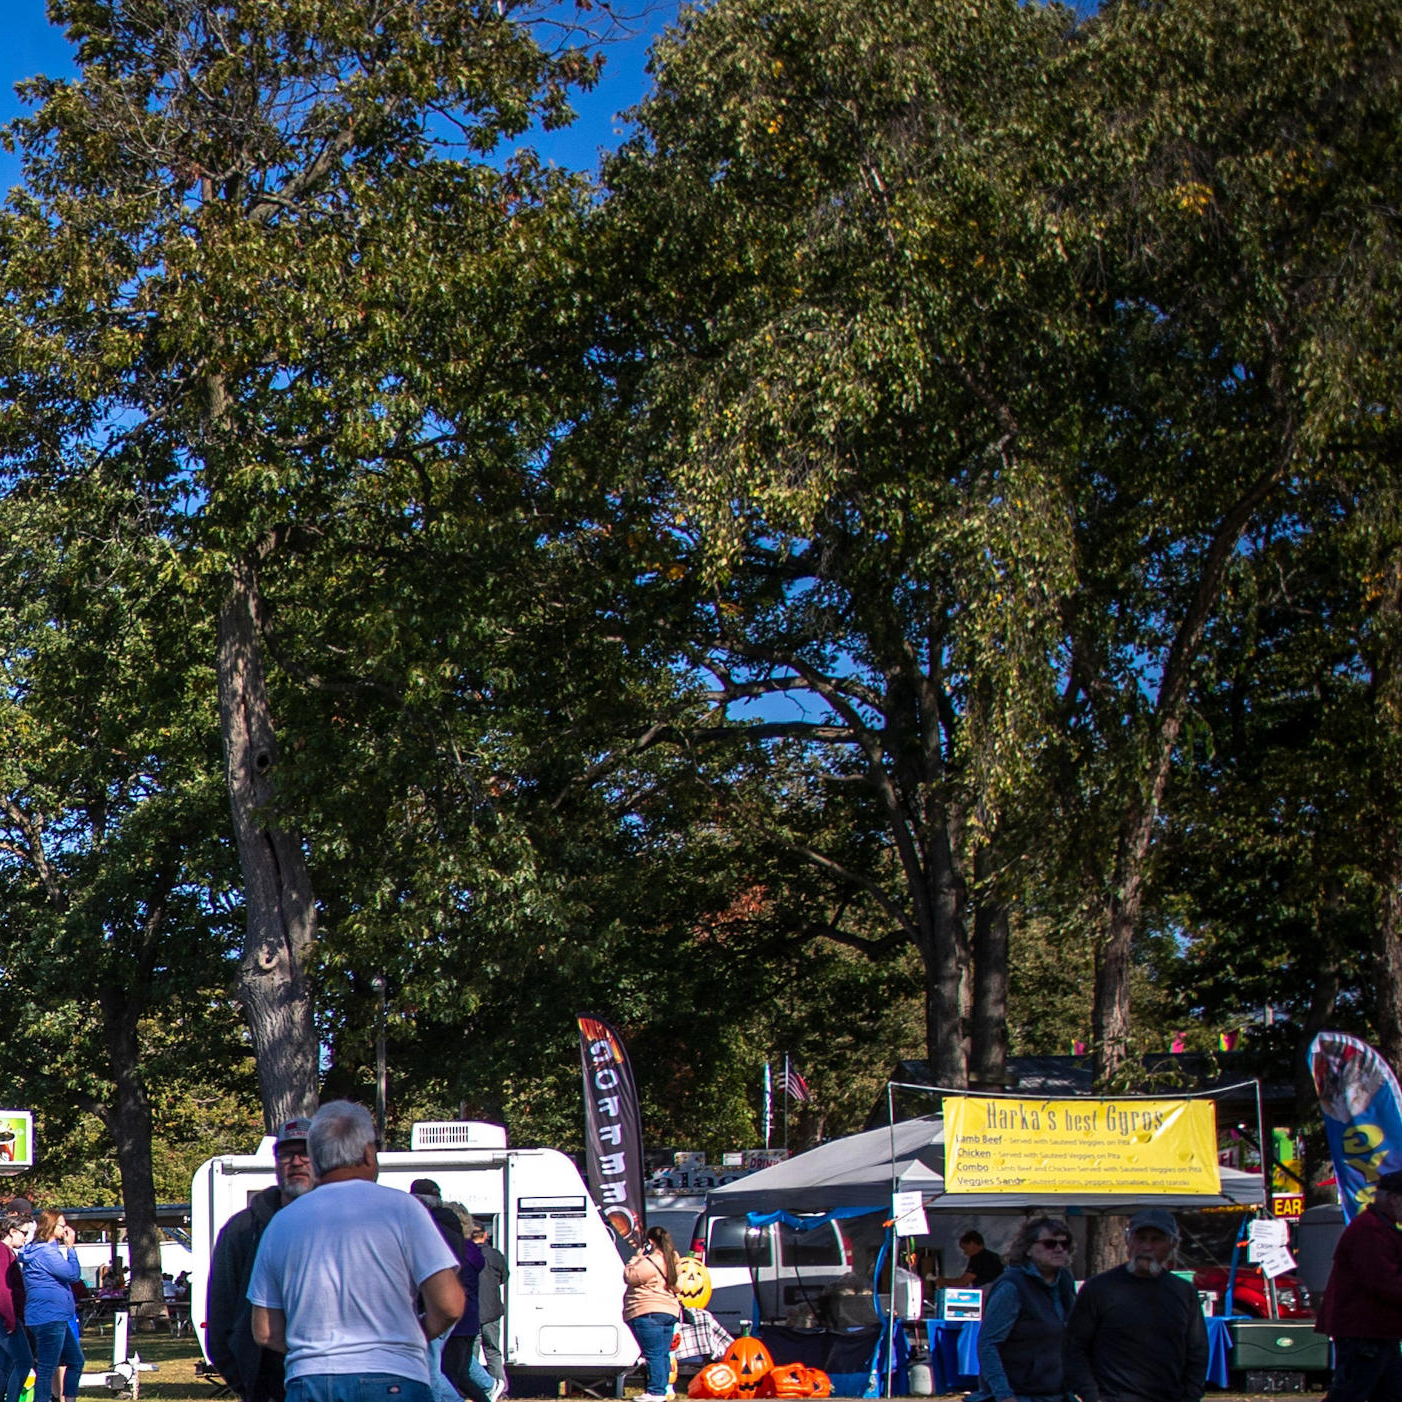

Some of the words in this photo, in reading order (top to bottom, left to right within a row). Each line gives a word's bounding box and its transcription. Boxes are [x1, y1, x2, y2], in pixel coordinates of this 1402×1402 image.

[987, 1100, 1057, 1130] Harka's
[1065, 1109, 1097, 1131] best
[1106, 1105, 1164, 1136] Gyros
[956, 1134, 980, 1143] Lamb
[982, 1134, 1003, 1144] Beef
[957, 1147, 991, 1158] Chicken
[956, 1162, 989, 1172] Combo
[652, 1171, 742, 1188] alac
[957, 1177, 994, 1187] Veggies
